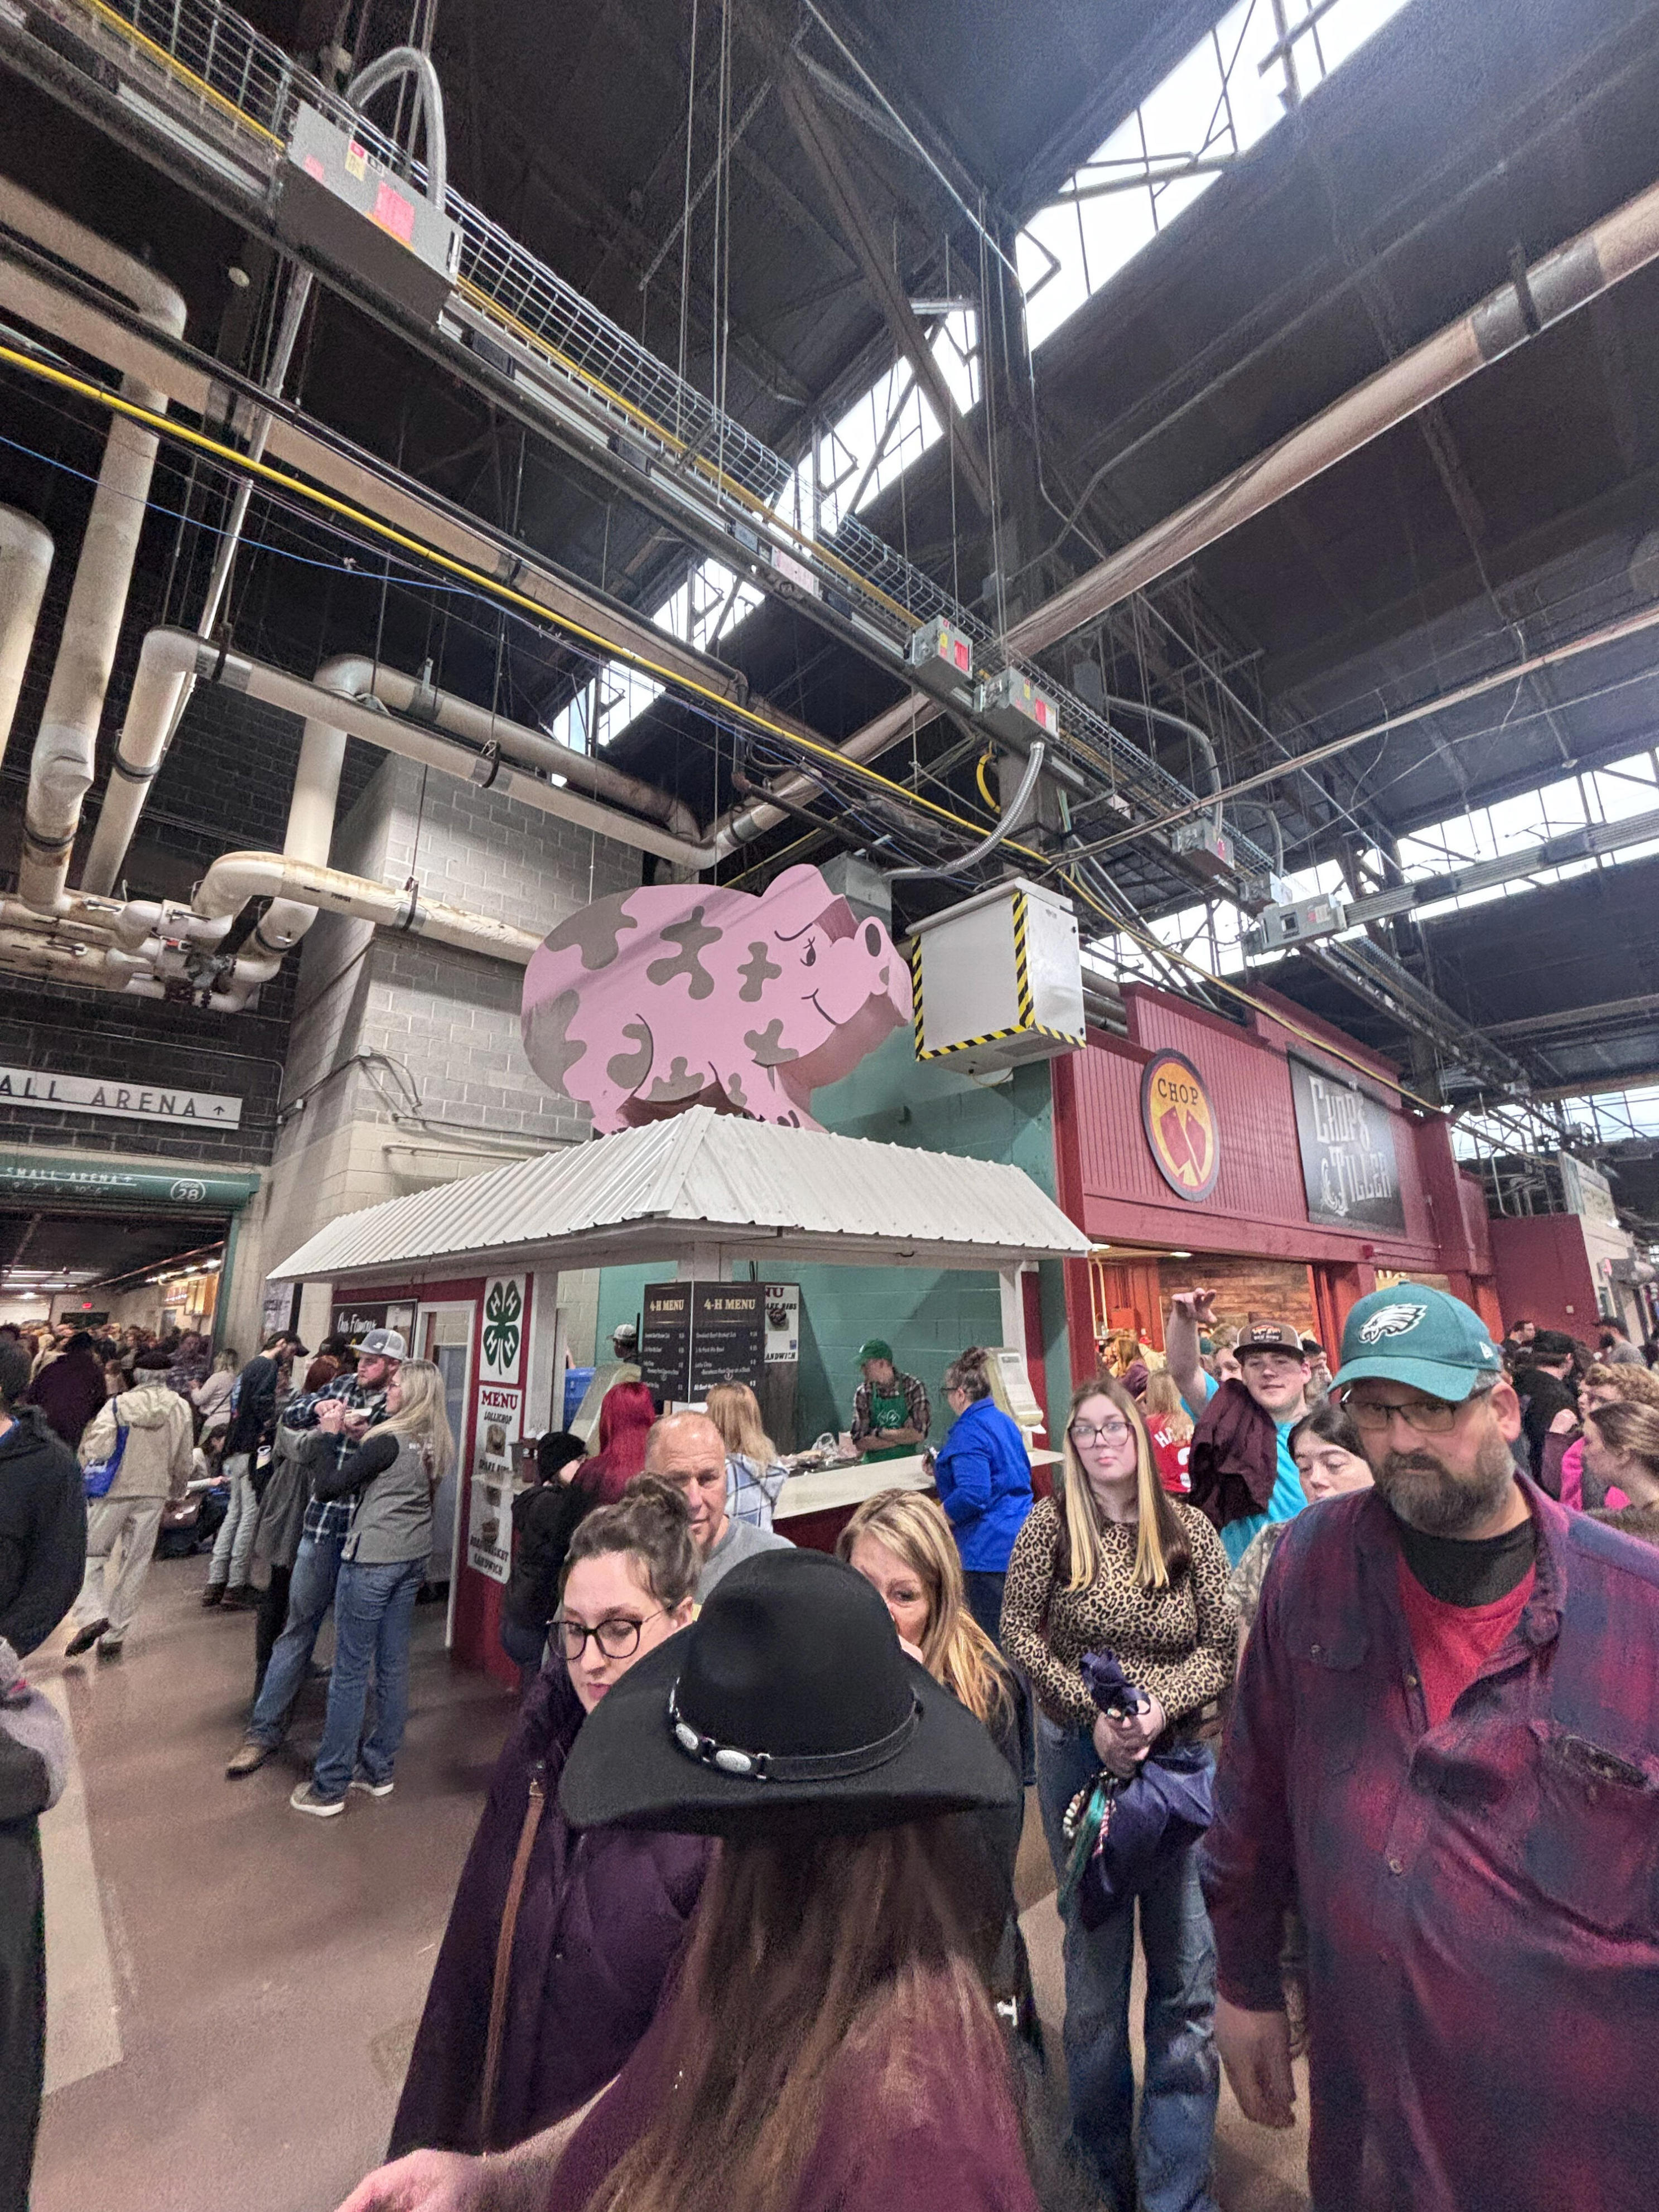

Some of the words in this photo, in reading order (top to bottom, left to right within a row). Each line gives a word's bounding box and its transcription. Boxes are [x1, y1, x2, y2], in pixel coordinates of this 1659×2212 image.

[1158, 1078, 1198, 1105] CHOP
[91, 1086, 196, 1117] ARENA
[7, 1167, 55, 1179] SMALL
[70, 1172, 117, 1184] ARENA
[175, 1188, 199, 1200] 28
[649, 1300, 662, 1311] 4-H
[663, 1299, 684, 1311] MENU
[703, 1298, 723, 1310] 4-H
[725, 1298, 756, 1310] MENU
[481, 1390, 518, 1410] MENU
